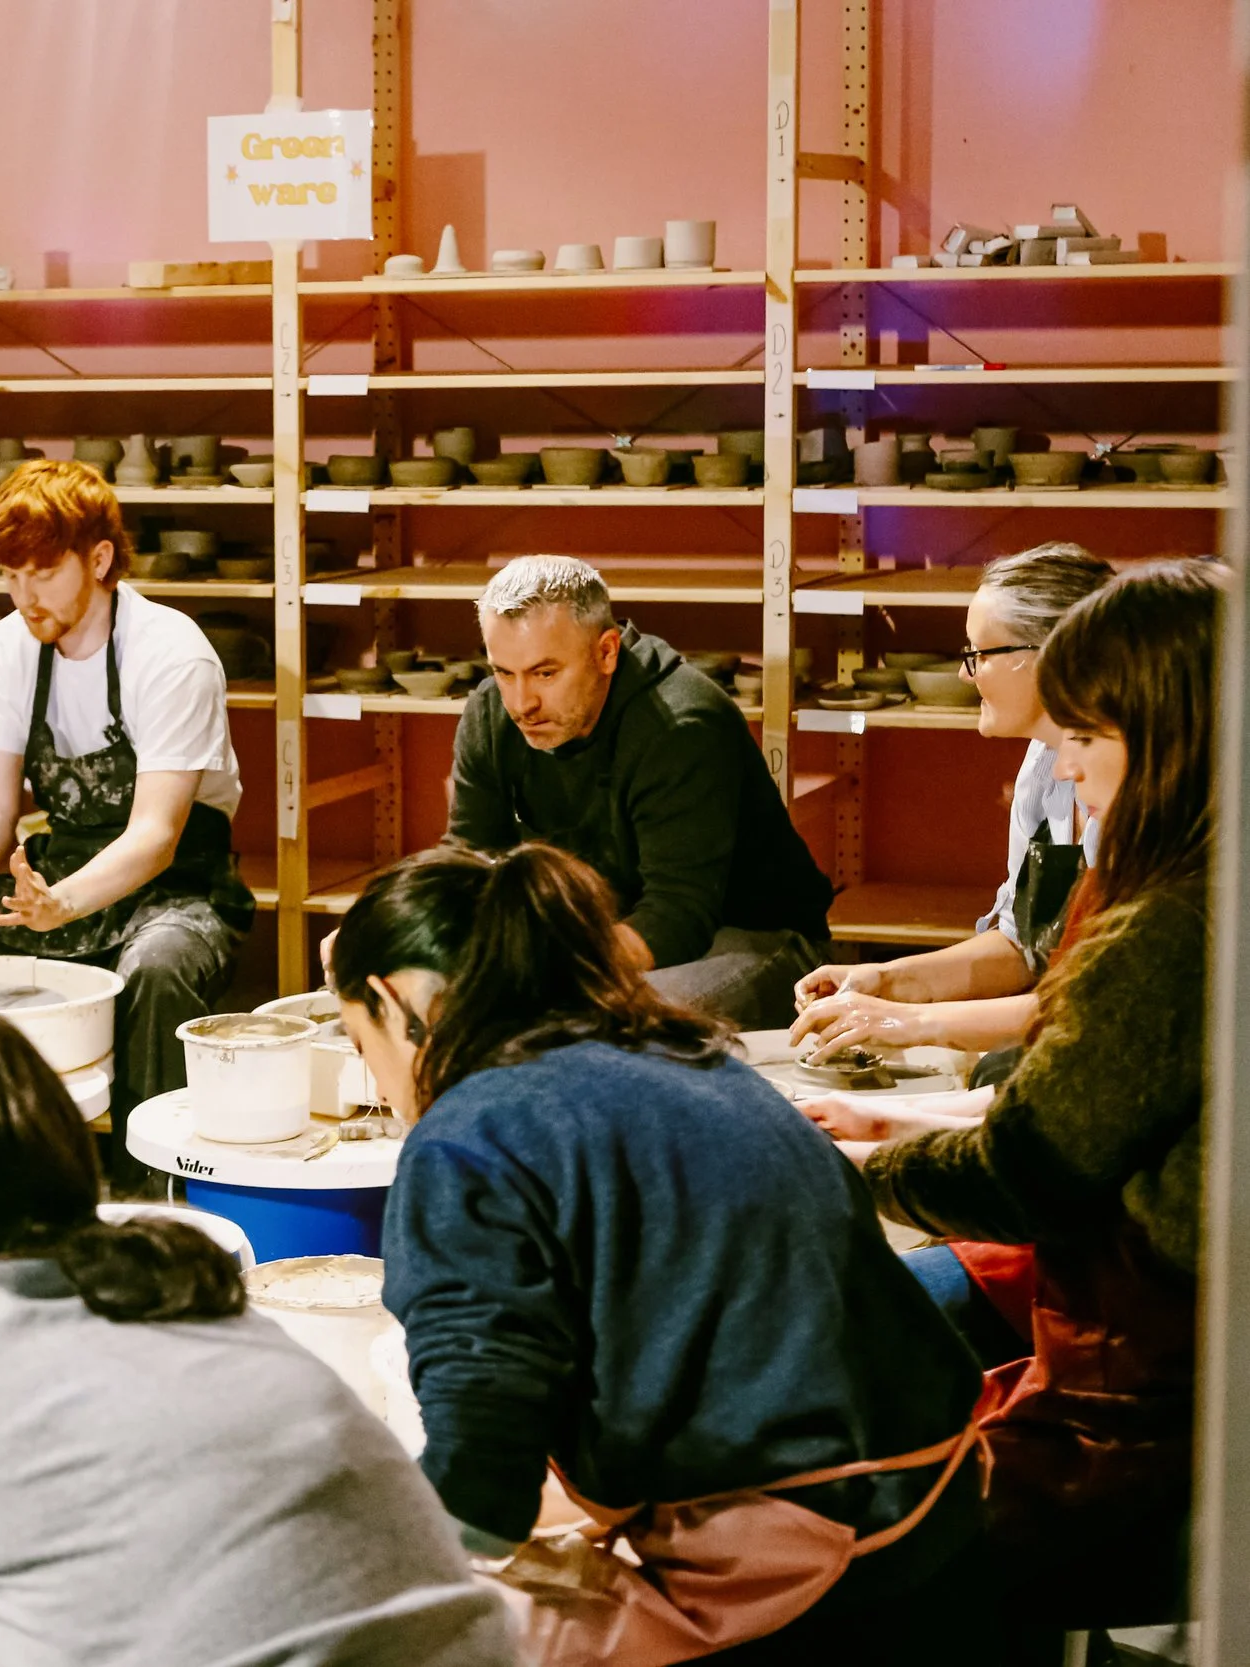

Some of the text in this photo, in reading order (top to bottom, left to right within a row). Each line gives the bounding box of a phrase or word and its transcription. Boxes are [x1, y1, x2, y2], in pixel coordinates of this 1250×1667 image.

[241, 132, 345, 160] Green
[775, 100, 790, 156] D1
[248, 182, 338, 206] ware
[279, 322, 292, 375] C2
[771, 323, 787, 395] D2
[281, 535, 294, 585] C3
[769, 540, 786, 598] D3
[281, 739, 295, 791] C4
[770, 748, 783, 788] D
